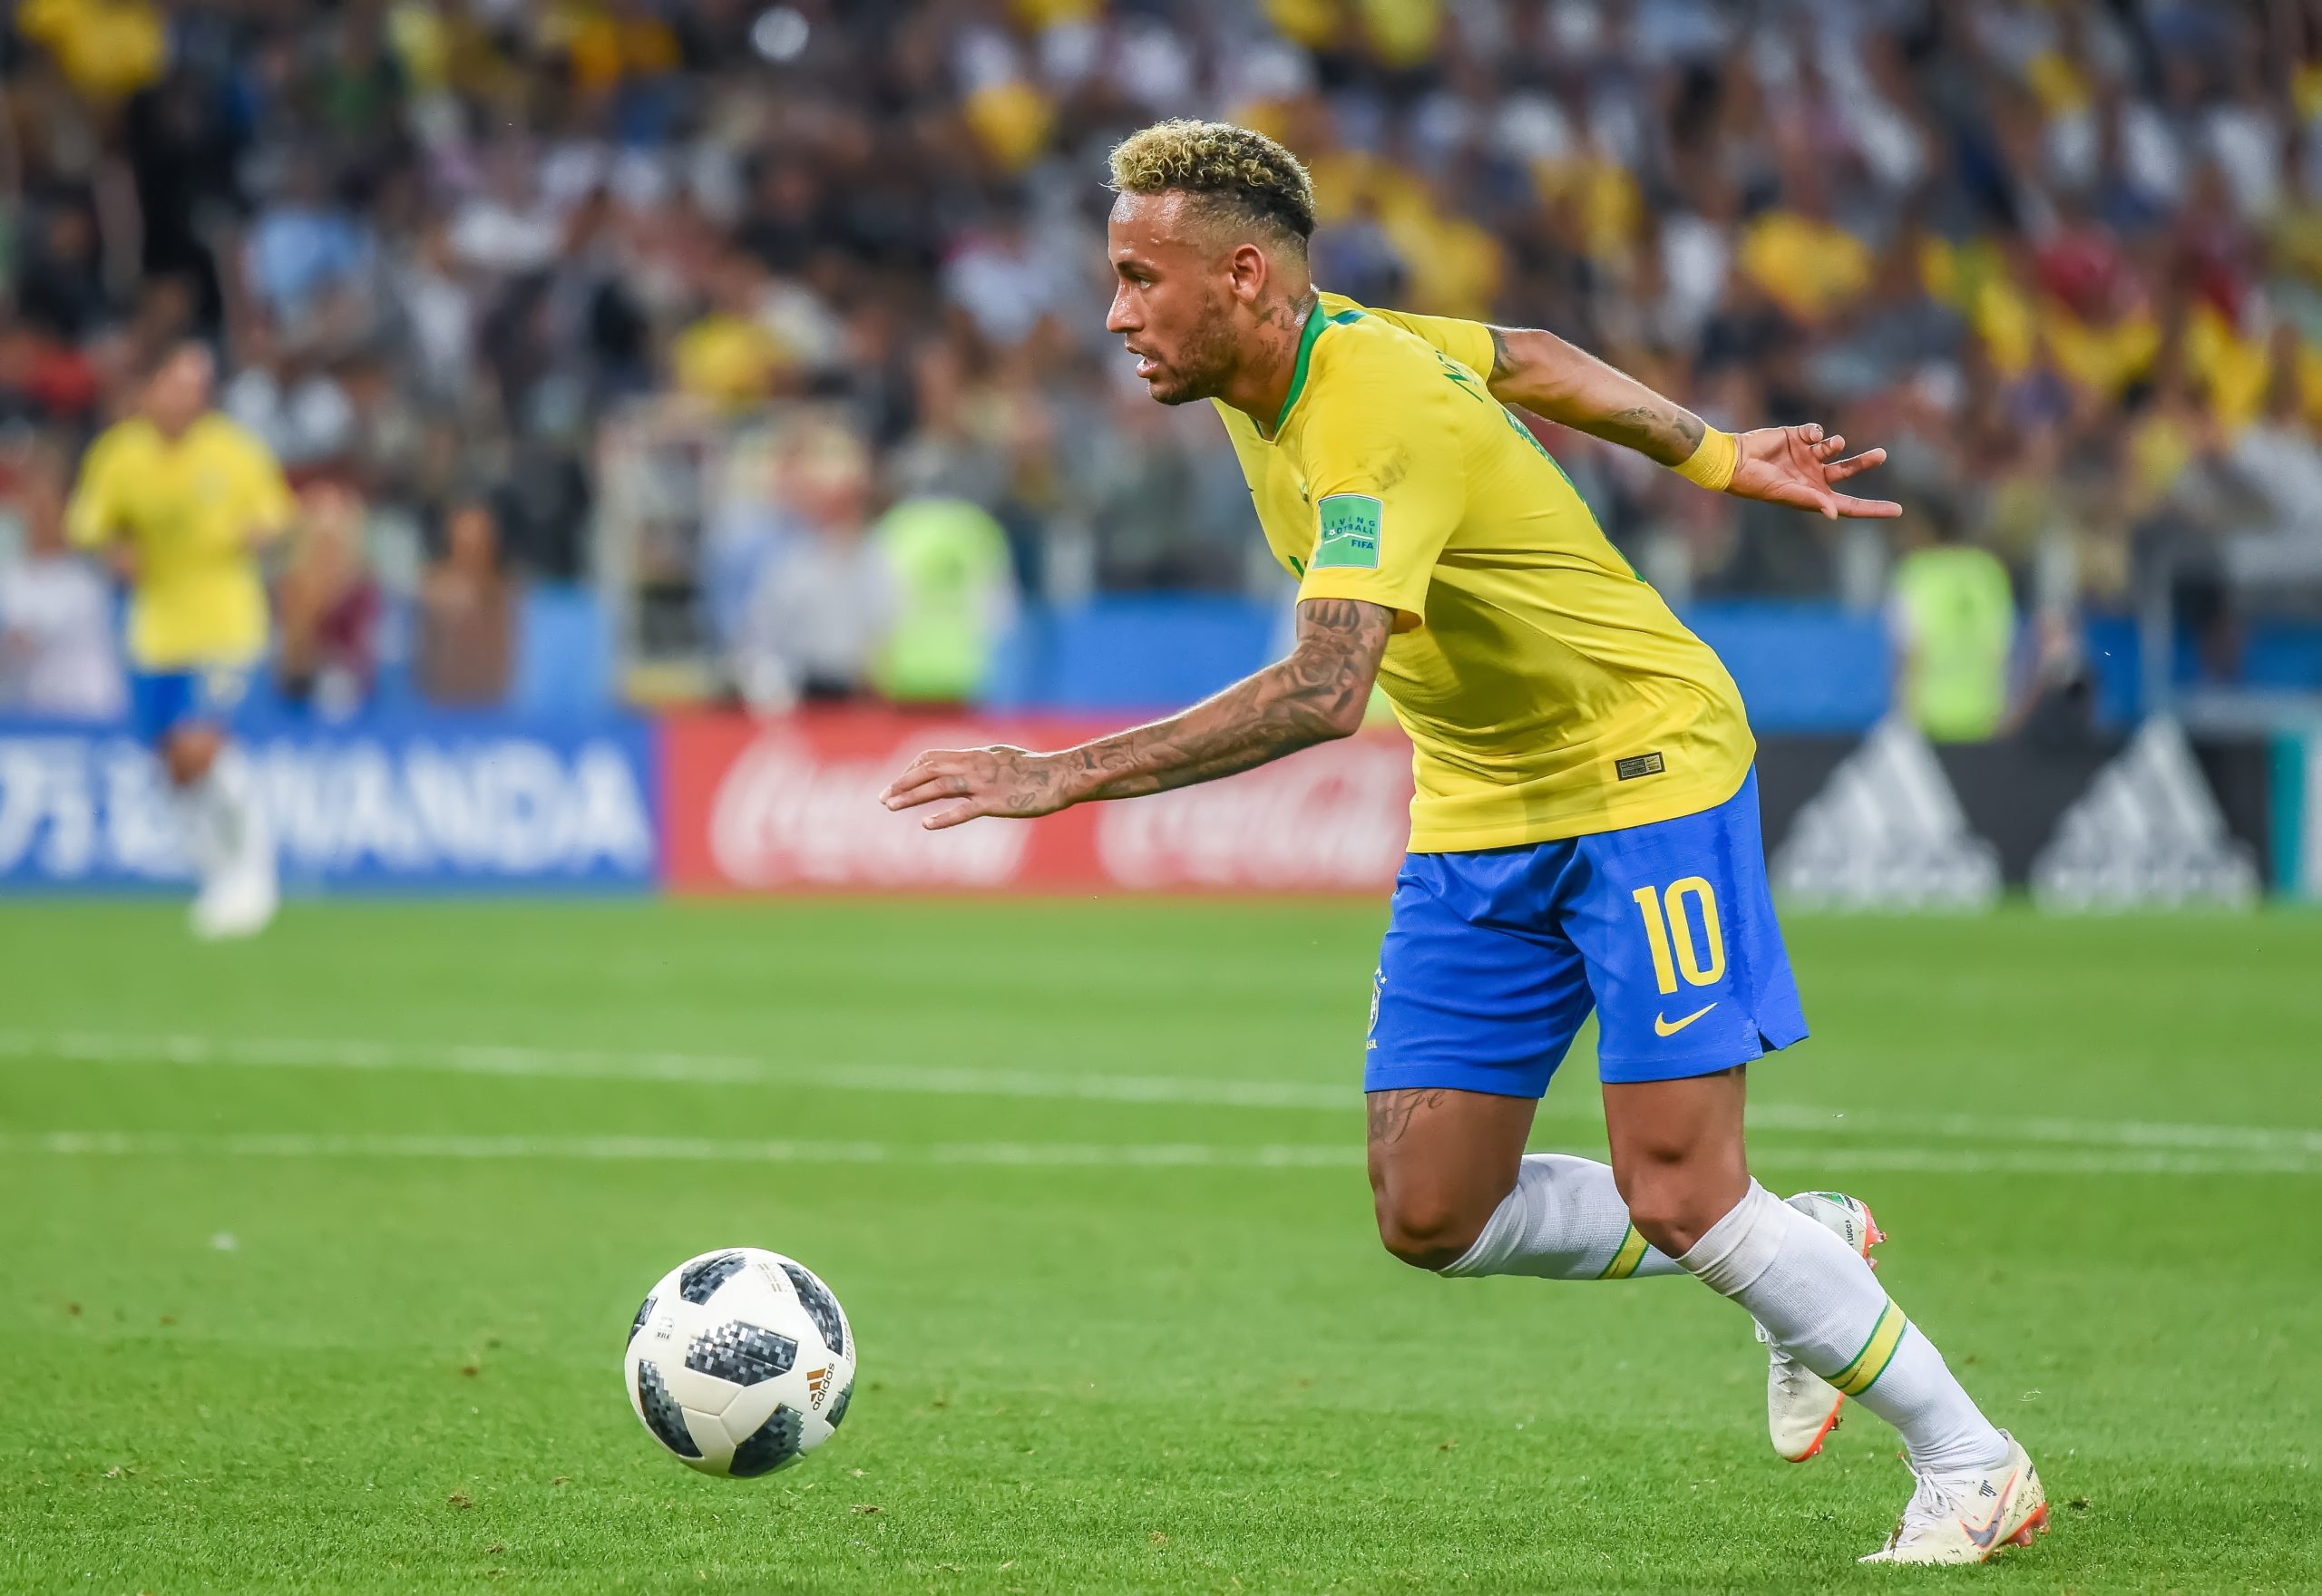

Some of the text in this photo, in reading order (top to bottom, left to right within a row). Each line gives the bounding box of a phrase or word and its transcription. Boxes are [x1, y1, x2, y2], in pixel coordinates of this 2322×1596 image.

[1323, 516, 1376, 530] LIVING
[1351, 539, 1374, 550] FIFA
[1632, 875, 1726, 995] 10
[1845, 1218, 1854, 1242] LUCCA
[813, 1362, 834, 1411] adidas
